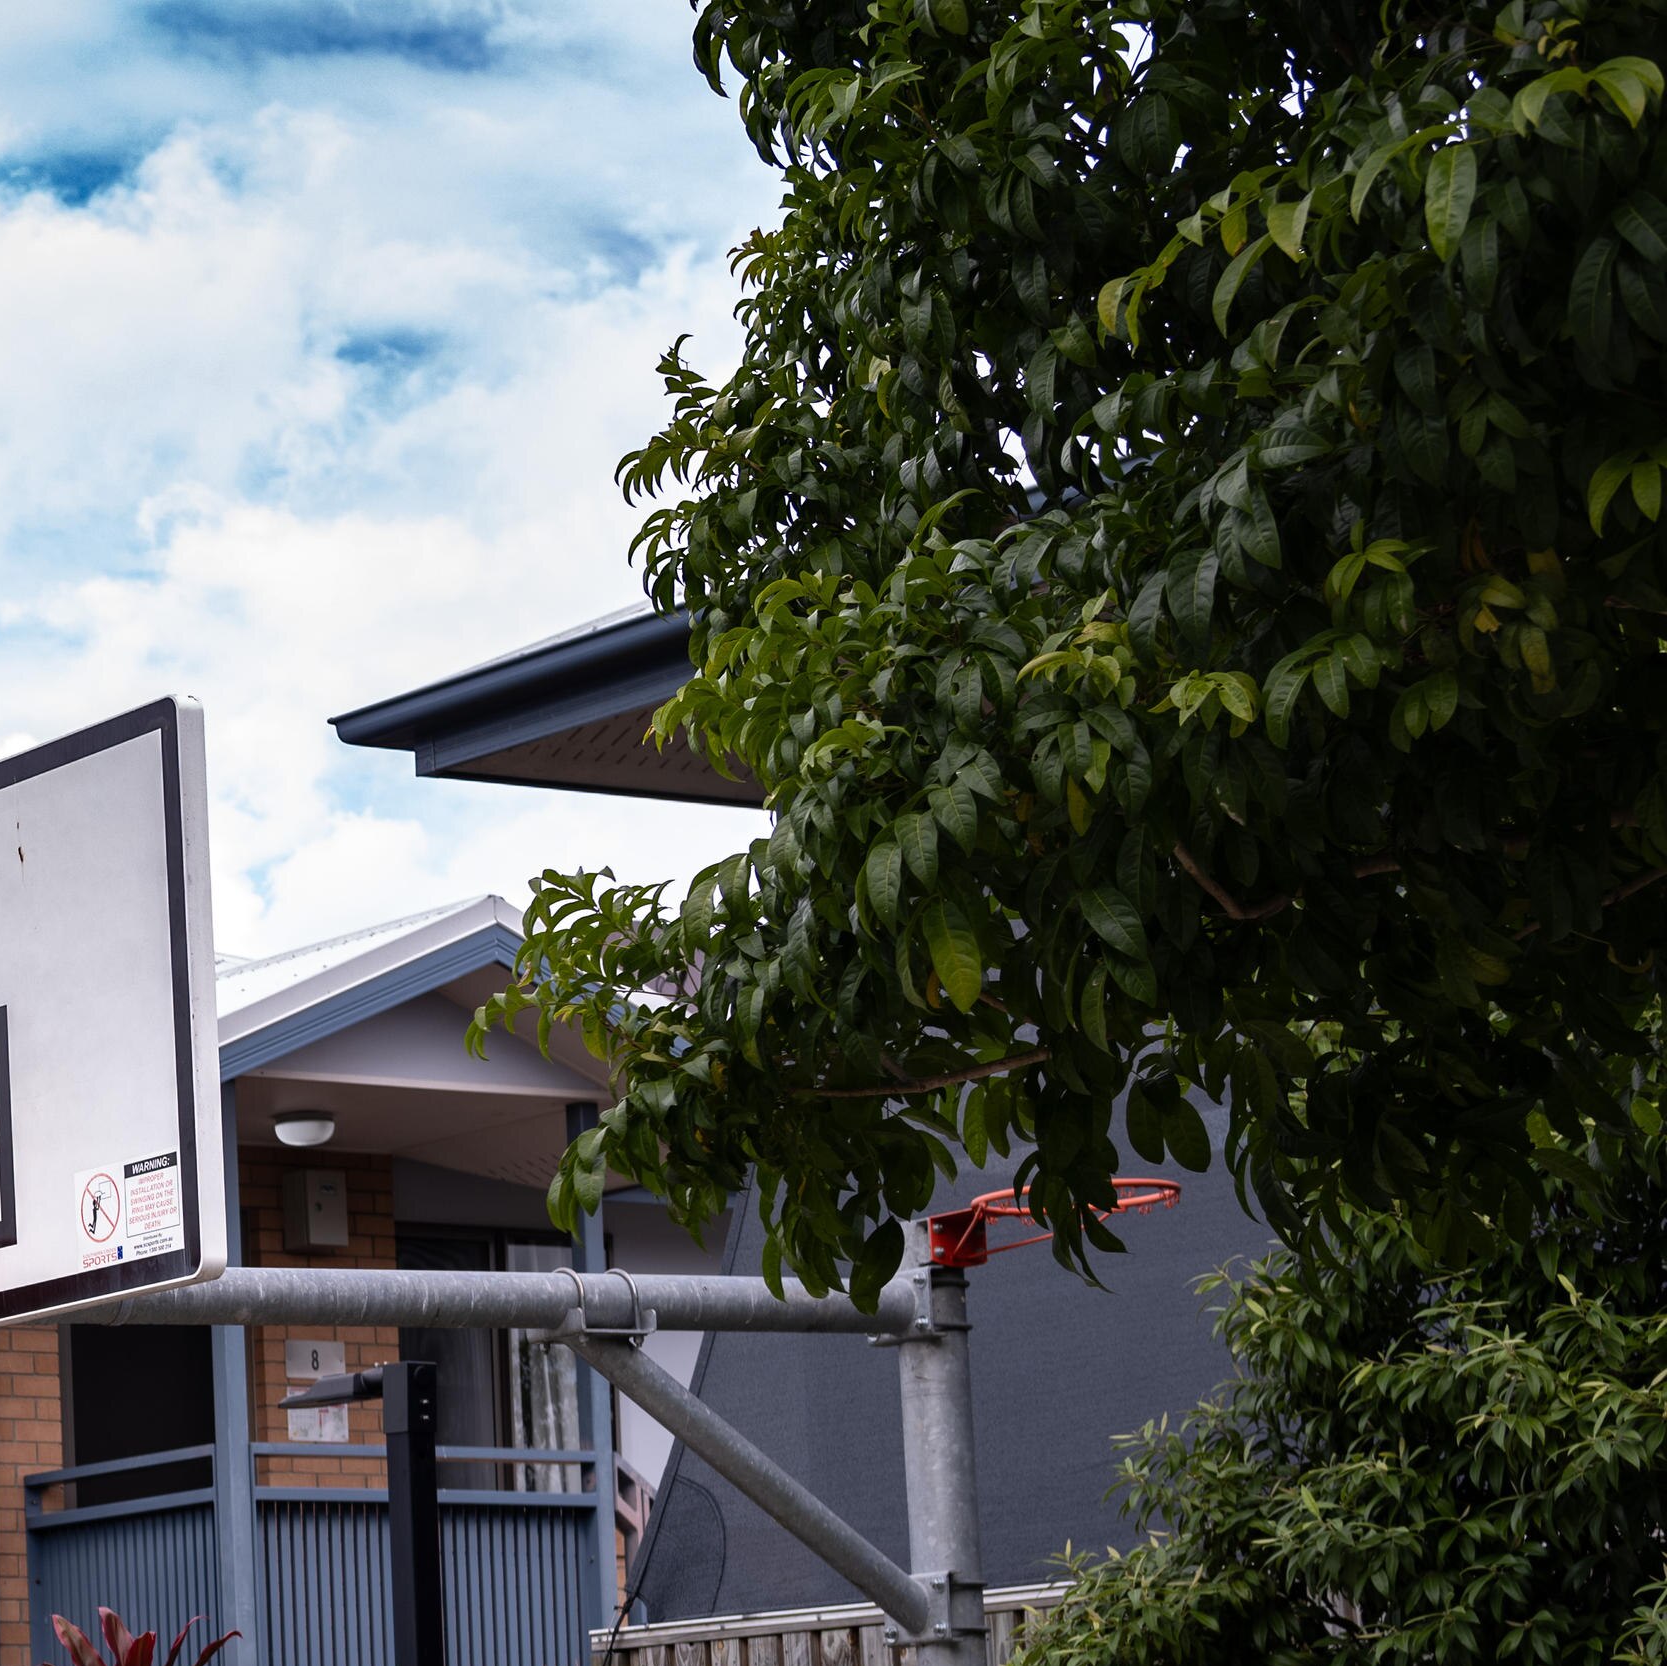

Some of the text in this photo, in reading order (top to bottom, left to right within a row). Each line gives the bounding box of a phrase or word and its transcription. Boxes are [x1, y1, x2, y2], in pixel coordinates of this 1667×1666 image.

[132, 1157, 170, 1174] WARNING:
[139, 1172, 164, 1184] IMPROPER
[131, 1179, 173, 1195] INSTALLATION OR
[131, 1188, 174, 1205] SWINGING ON THE
[131, 1198, 173, 1214] RING MAY CAUSE
[129, 1206, 177, 1225] SERIOUS INJURY OR
[83, 1252, 117, 1268] SPORTS
[311, 1349, 319, 1371] 8
